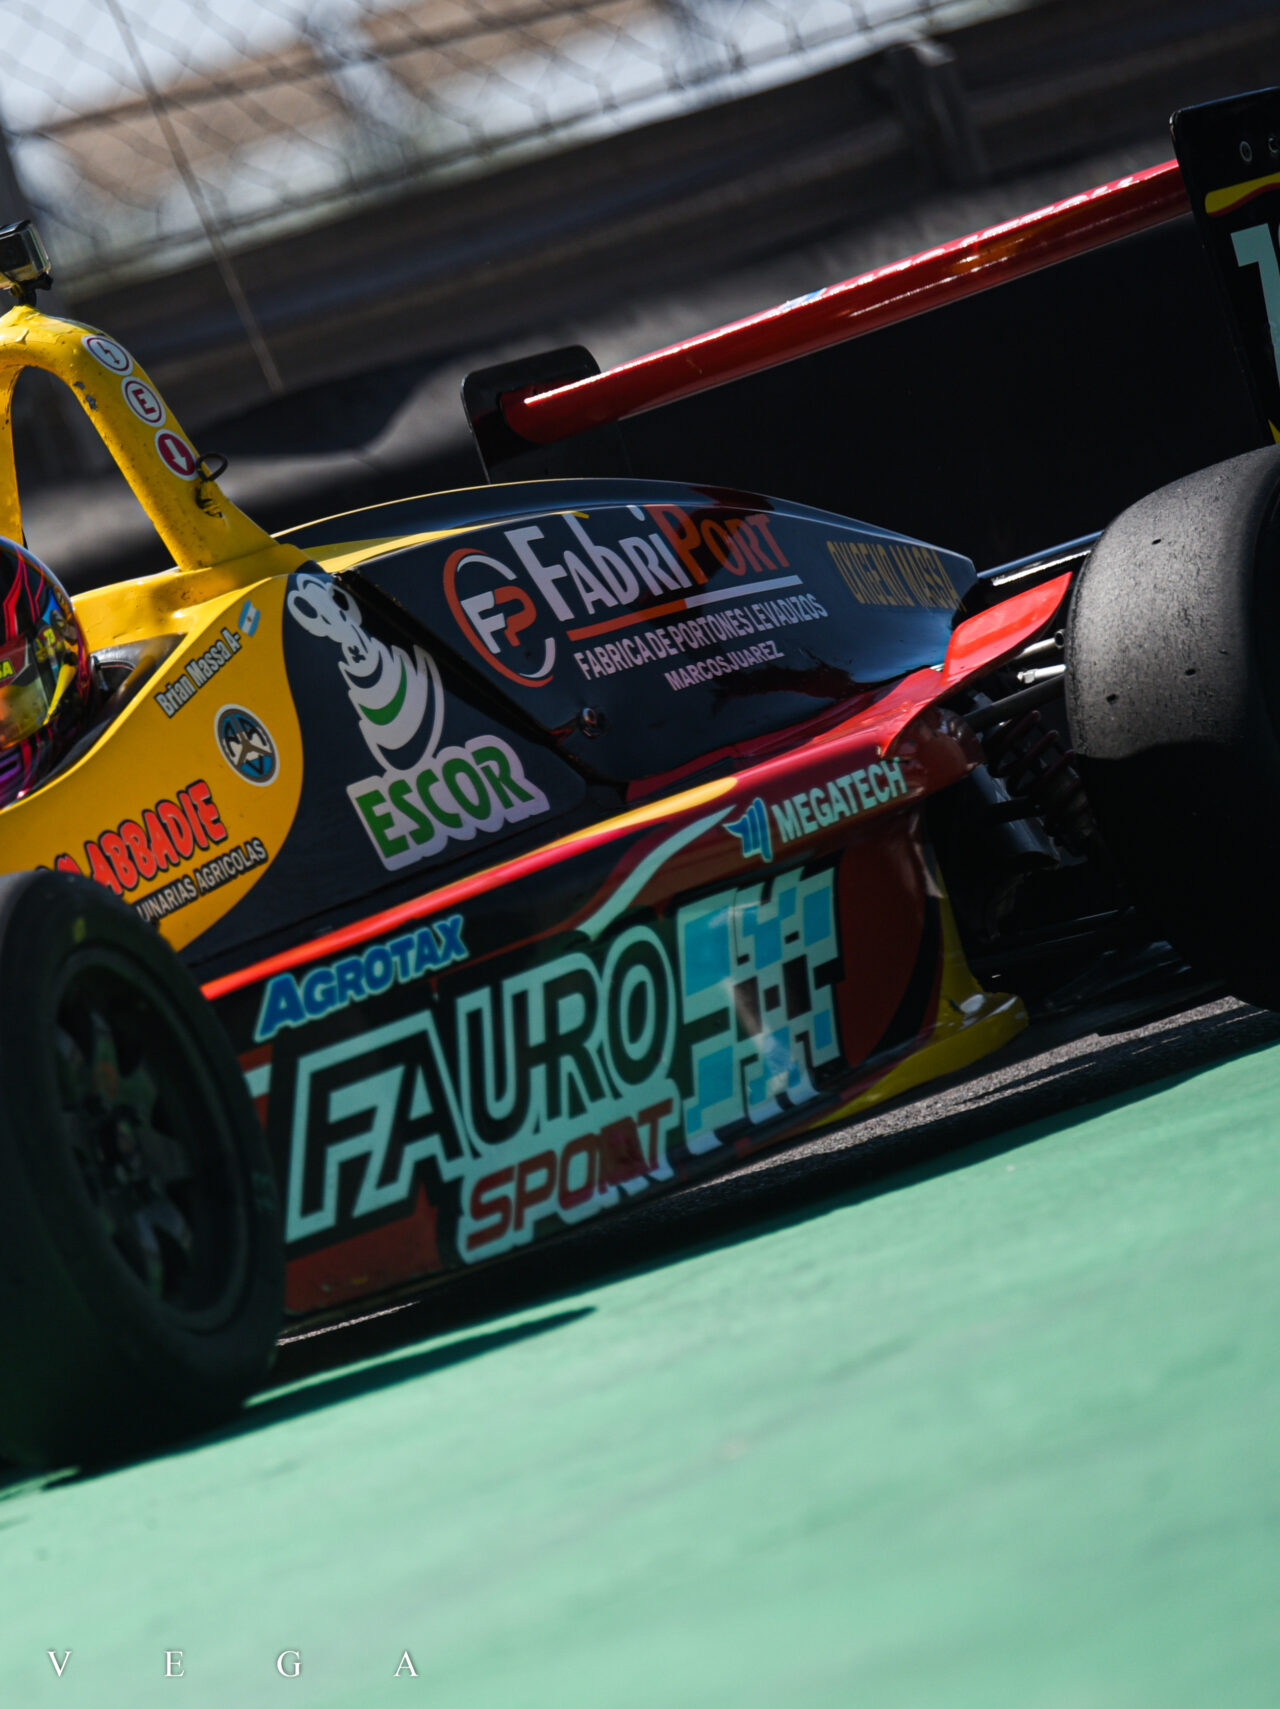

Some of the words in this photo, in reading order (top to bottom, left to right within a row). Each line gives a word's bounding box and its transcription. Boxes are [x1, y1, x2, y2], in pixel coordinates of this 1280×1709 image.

[155, 683, 197, 718] Brian
[185, 639, 232, 688] Massa
[573, 633, 652, 681] FABRICA
[648, 629, 673, 661] DE
[669, 605, 756, 655] PORTONES
[747, 592, 829, 633] LEVADIZOS
[663, 650, 732, 692] MARCOS
[728, 639, 785, 672] JUAREZ
[355, 745, 534, 861] ESCOR
[771, 757, 907, 843] MEGATECH
[137, 874, 199, 922] UINARIAS
[194, 838, 268, 893] AGRICOLAS
[257, 916, 468, 1039] AGROTAX
[286, 923, 677, 1243] FAURO
